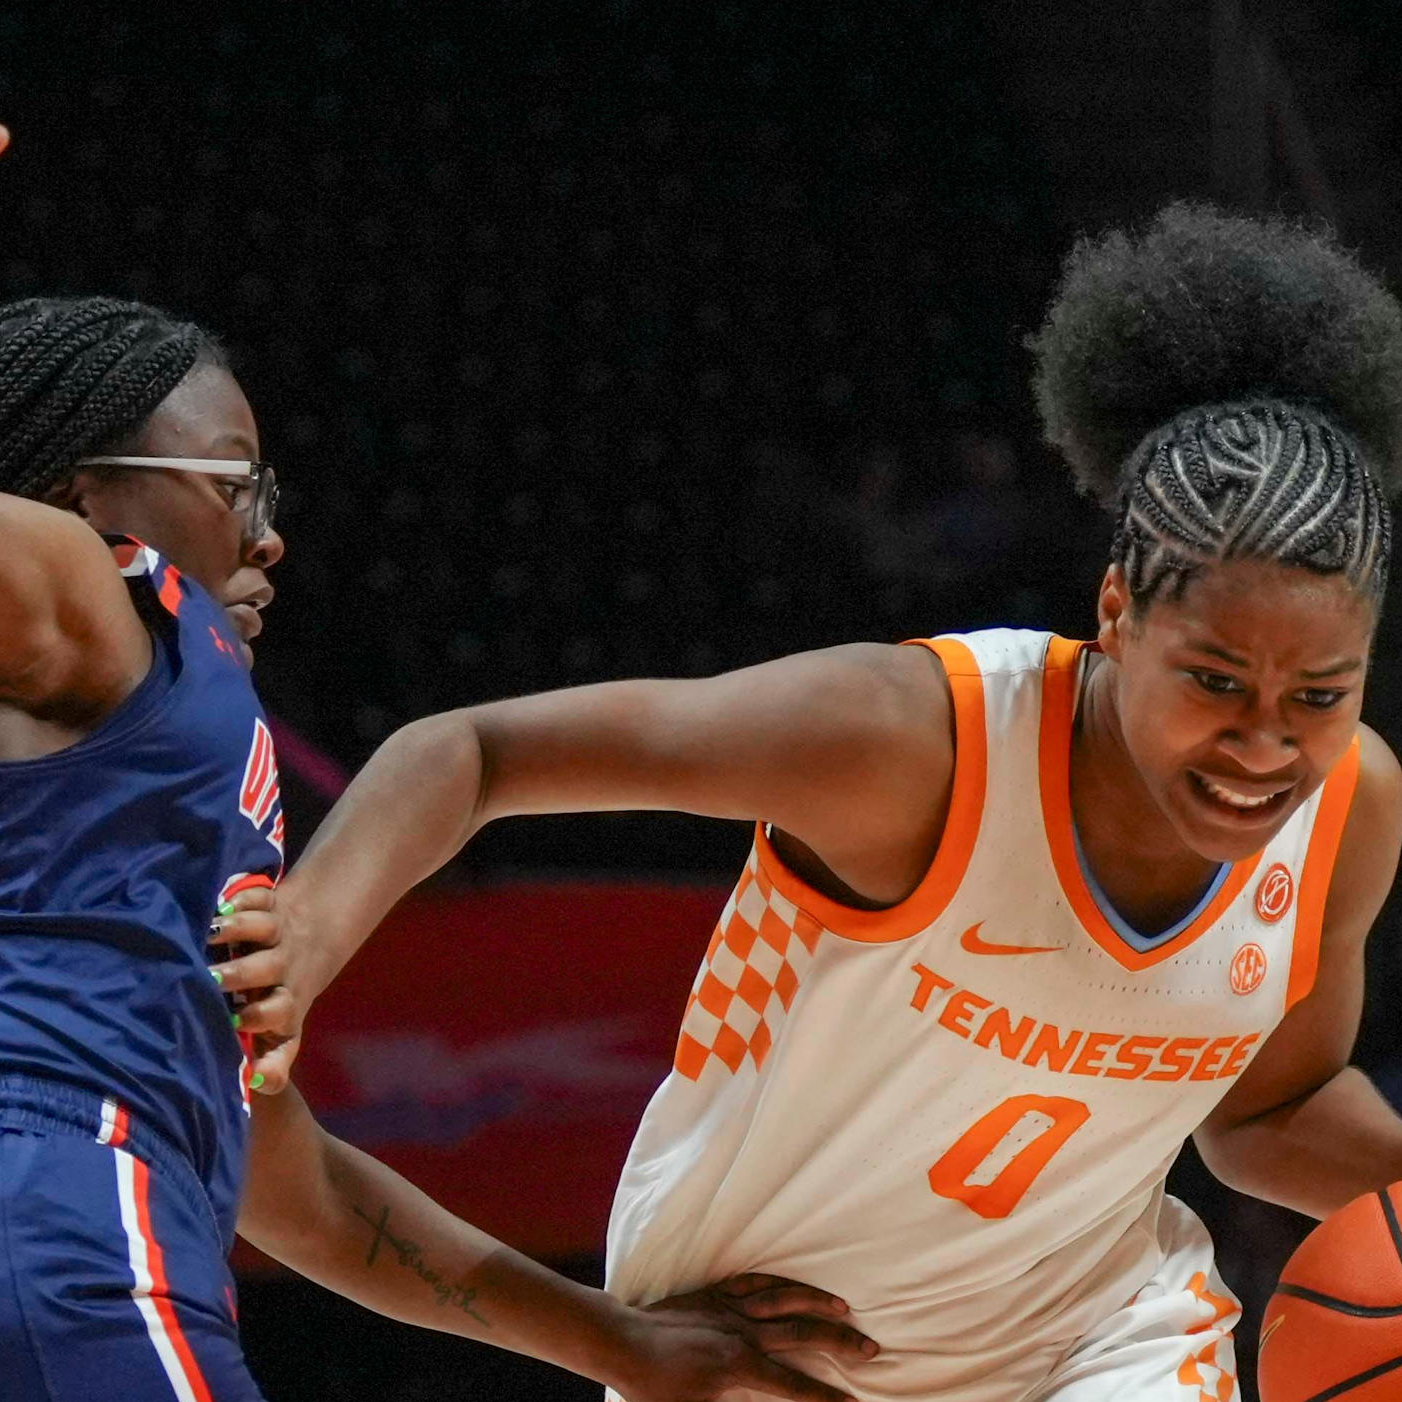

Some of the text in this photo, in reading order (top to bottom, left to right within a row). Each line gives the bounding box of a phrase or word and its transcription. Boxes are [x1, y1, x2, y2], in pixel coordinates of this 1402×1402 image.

[910, 963, 1261, 1081] TENNESSEE
[1231, 946, 1265, 990] SEC
[927, 1094, 1091, 1219] 0
